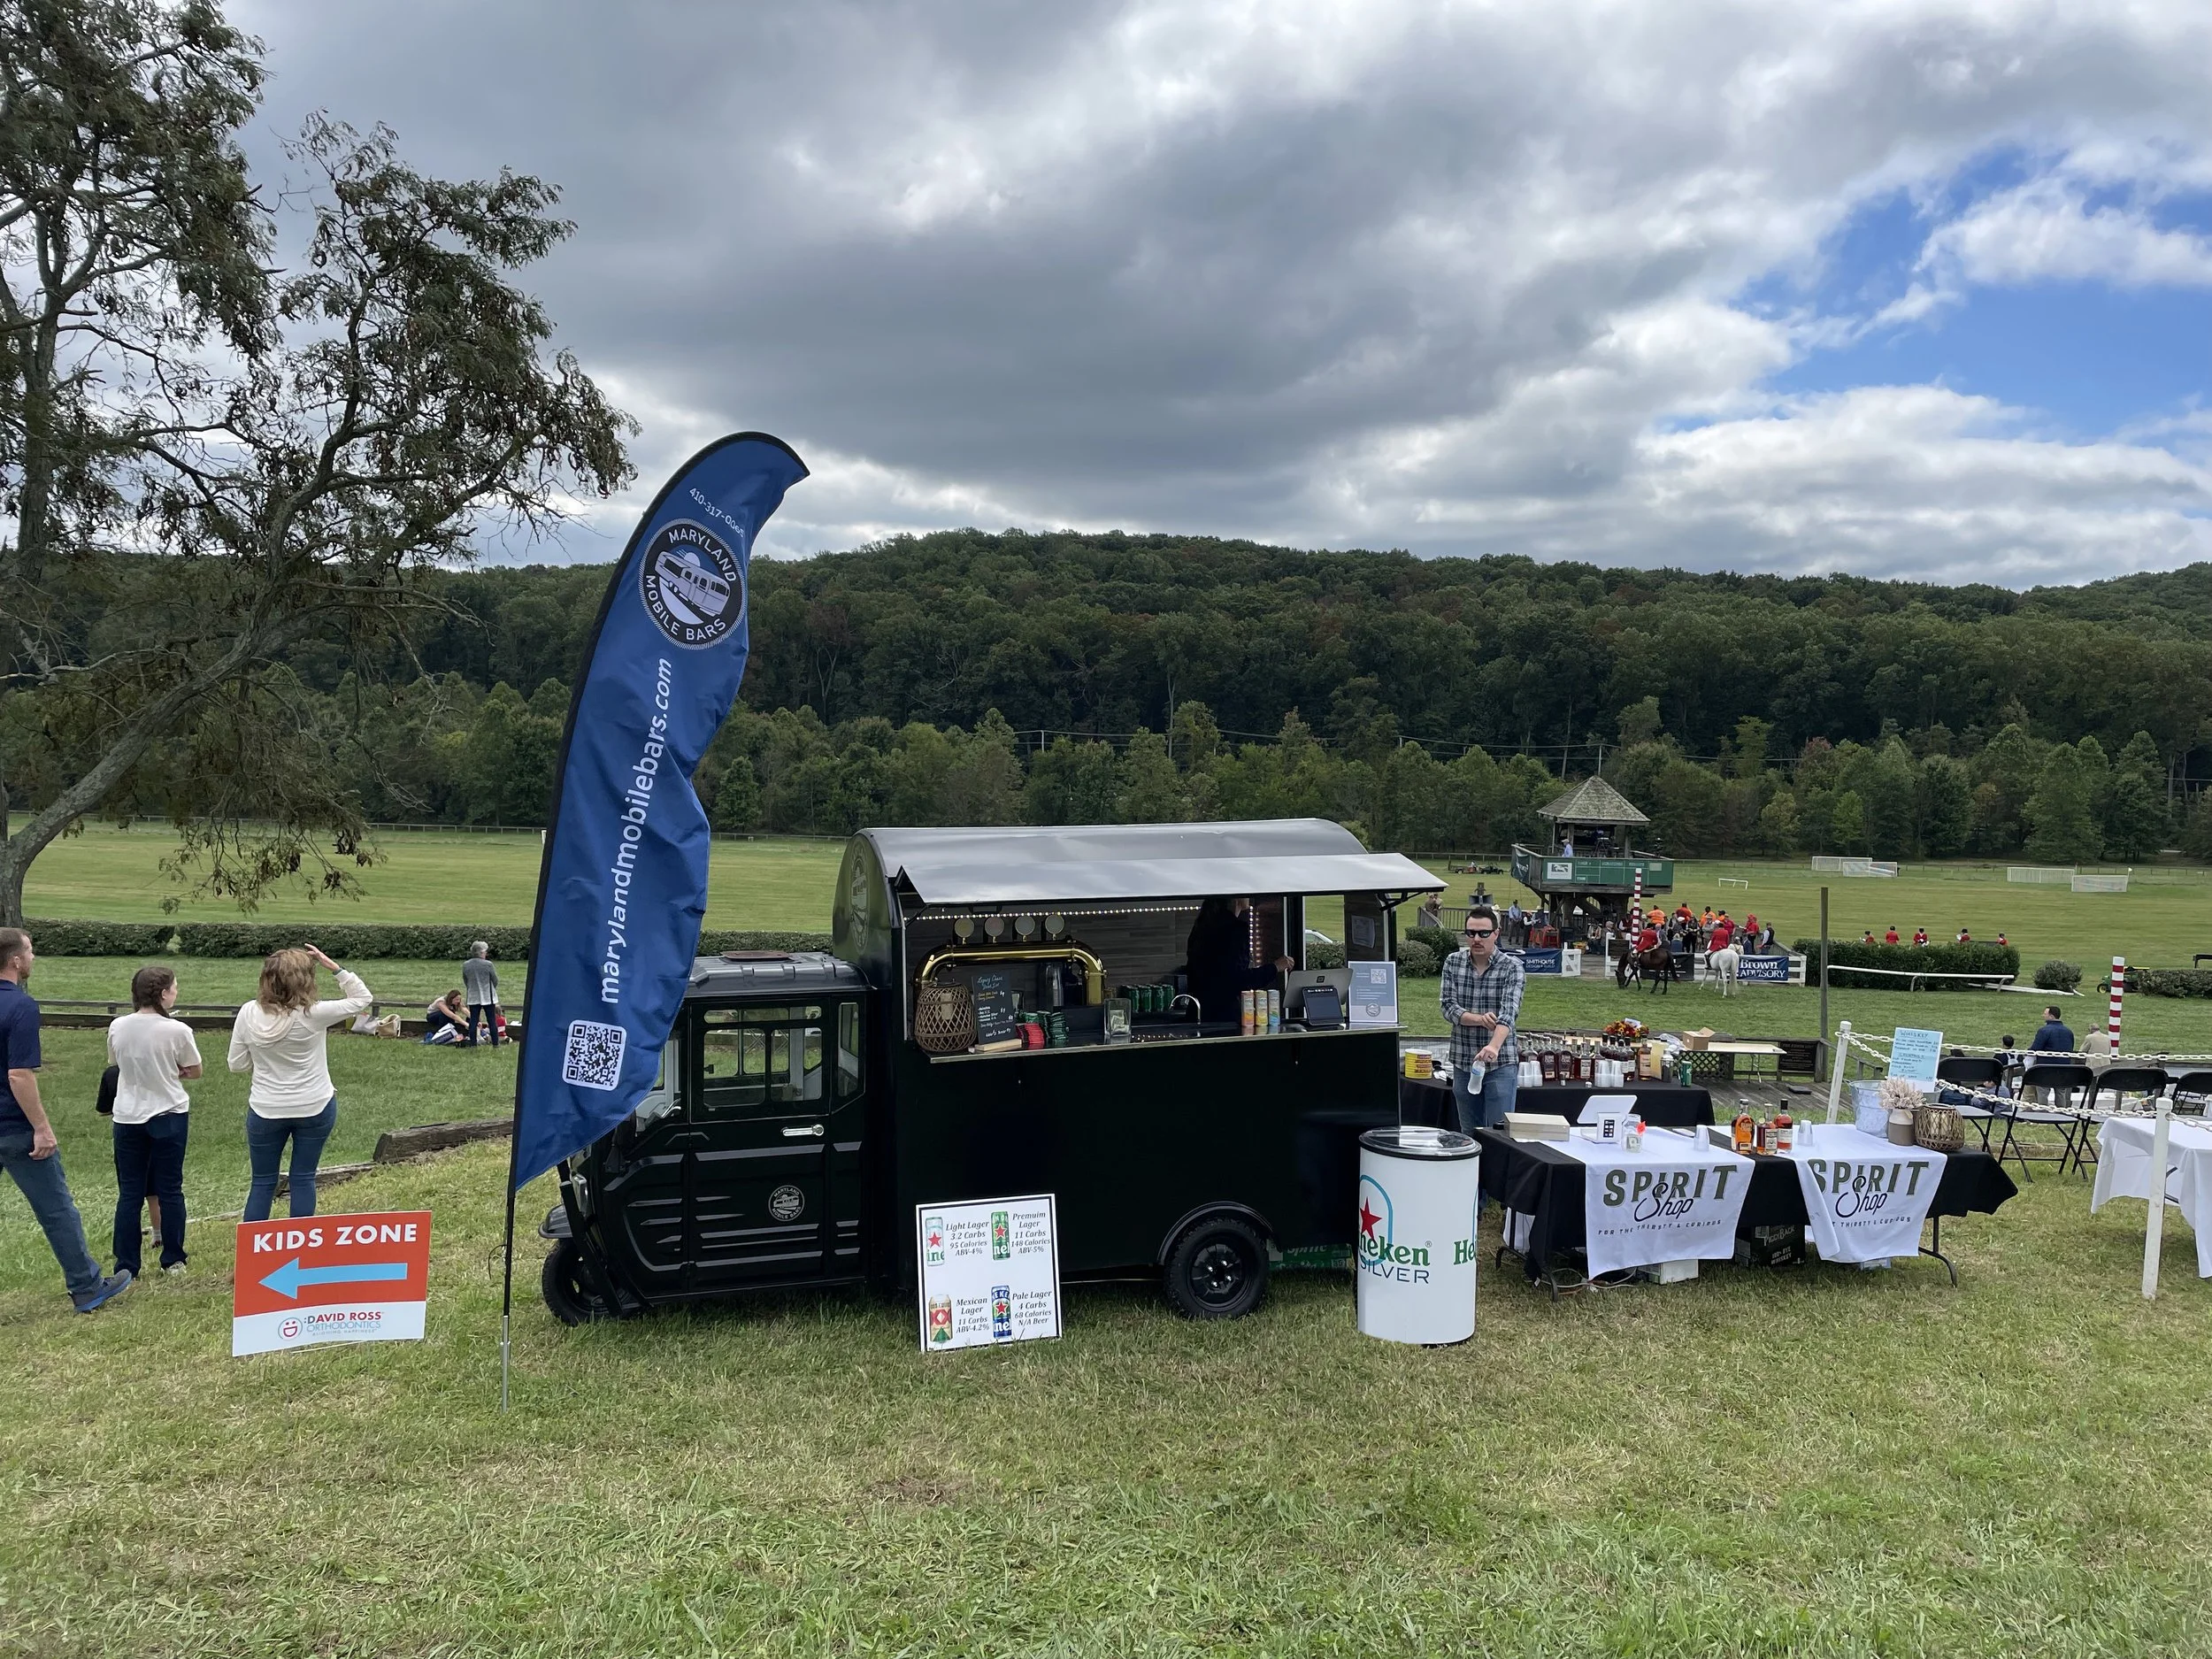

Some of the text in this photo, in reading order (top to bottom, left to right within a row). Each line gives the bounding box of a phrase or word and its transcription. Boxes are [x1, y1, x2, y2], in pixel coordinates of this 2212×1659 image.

[668, 528, 737, 582] MARYLAND
[645, 574, 726, 641] MOBILE BARS
[601, 657, 672, 1004] marylandmobilebars.com
[1740, 959, 1778, 970] Brown
[1740, 969, 1786, 979] ADVISORY
[1602, 1164, 1737, 1207] SPIRIT
[1807, 1158, 1930, 1196] SPIRIT
[1634, 1182, 1694, 1222] Shop
[1835, 1175, 1888, 1218] Shop
[1012, 1211, 1046, 1220] Premuim
[946, 1221, 989, 1232] Light Lager
[253, 1223, 418, 1253] KIDS ZONE
[1360, 1255, 1430, 1284] SILVER
[956, 1297, 987, 1306] Mexican
[1030, 1291, 1052, 1300] Lager
[349, 1311, 381, 1320] ROSS
[306, 1320, 381, 1333] ORTHODONTICS
[956, 1324, 990, 1333] ABV-4.2%
